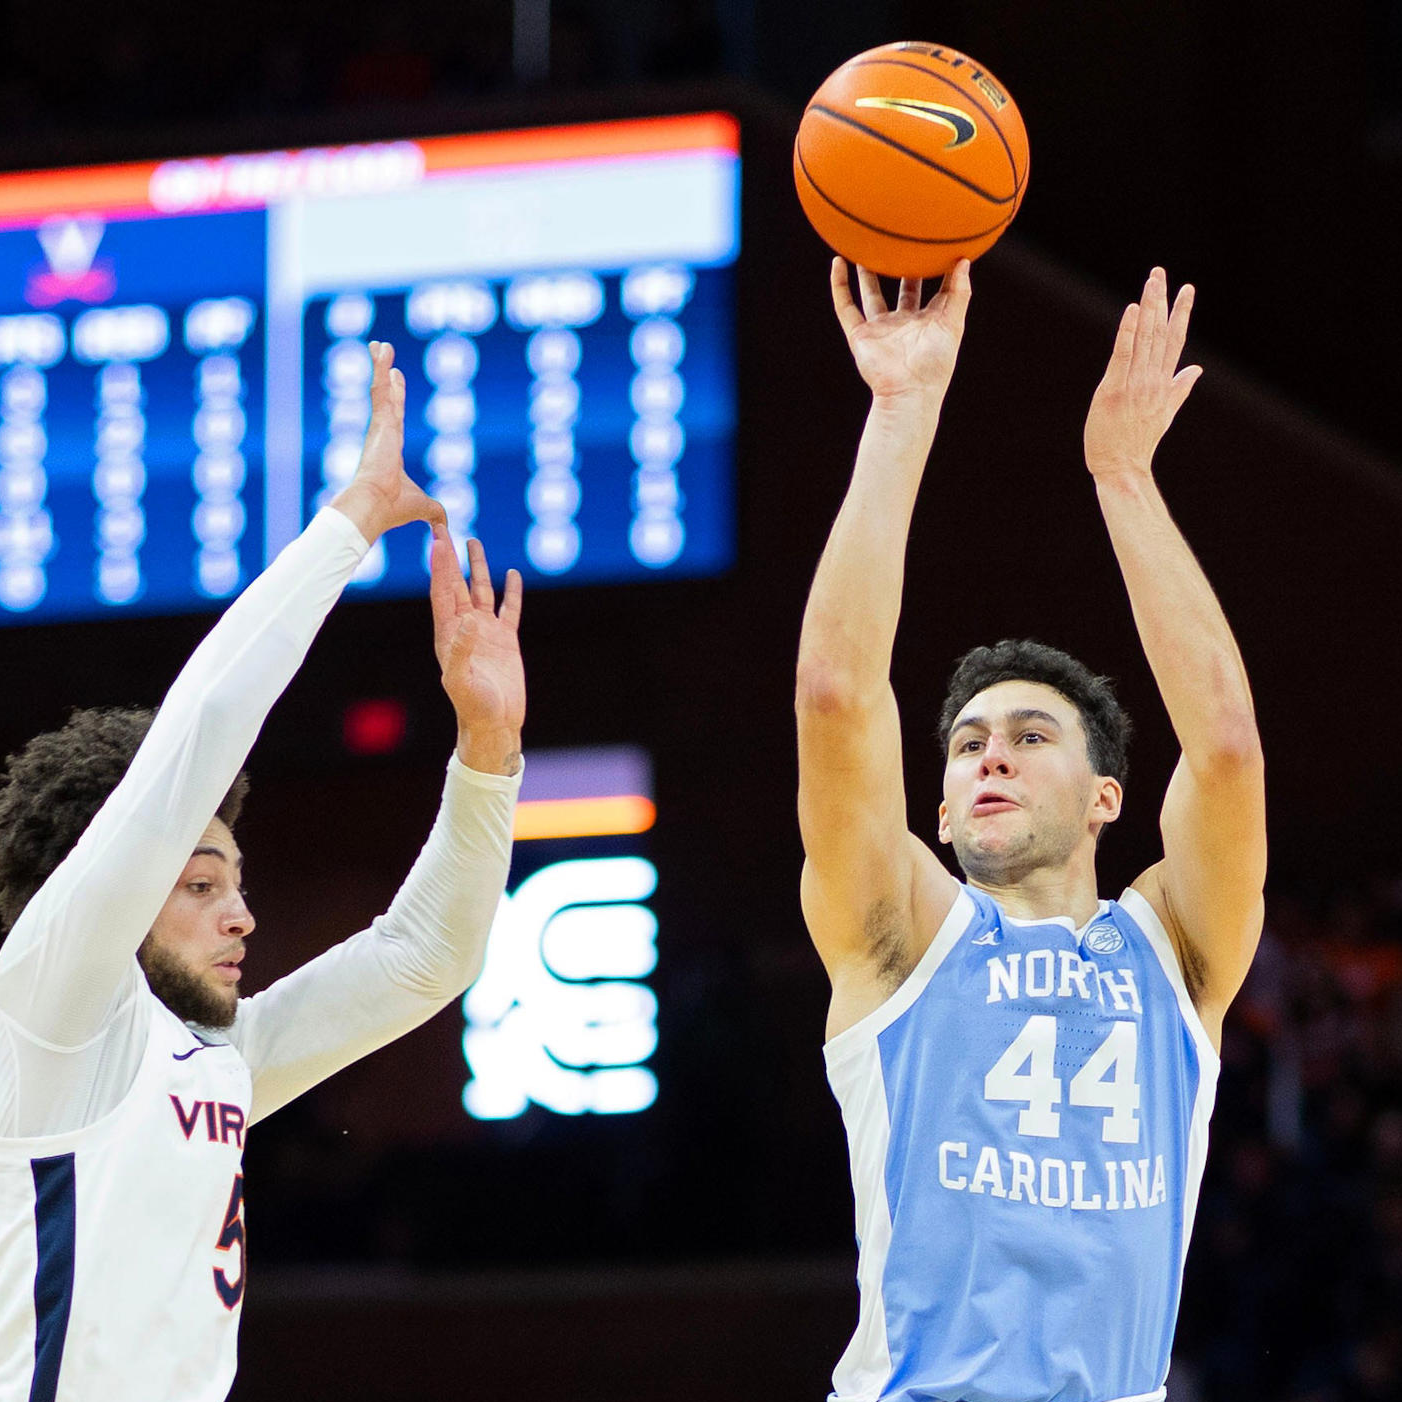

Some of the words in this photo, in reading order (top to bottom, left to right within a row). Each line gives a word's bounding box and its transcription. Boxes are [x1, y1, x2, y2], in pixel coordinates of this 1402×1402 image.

[986, 949, 1143, 1015] NORTH
[984, 1015, 1141, 1144] 44
[939, 1141, 1167, 1211] CAROLINA
